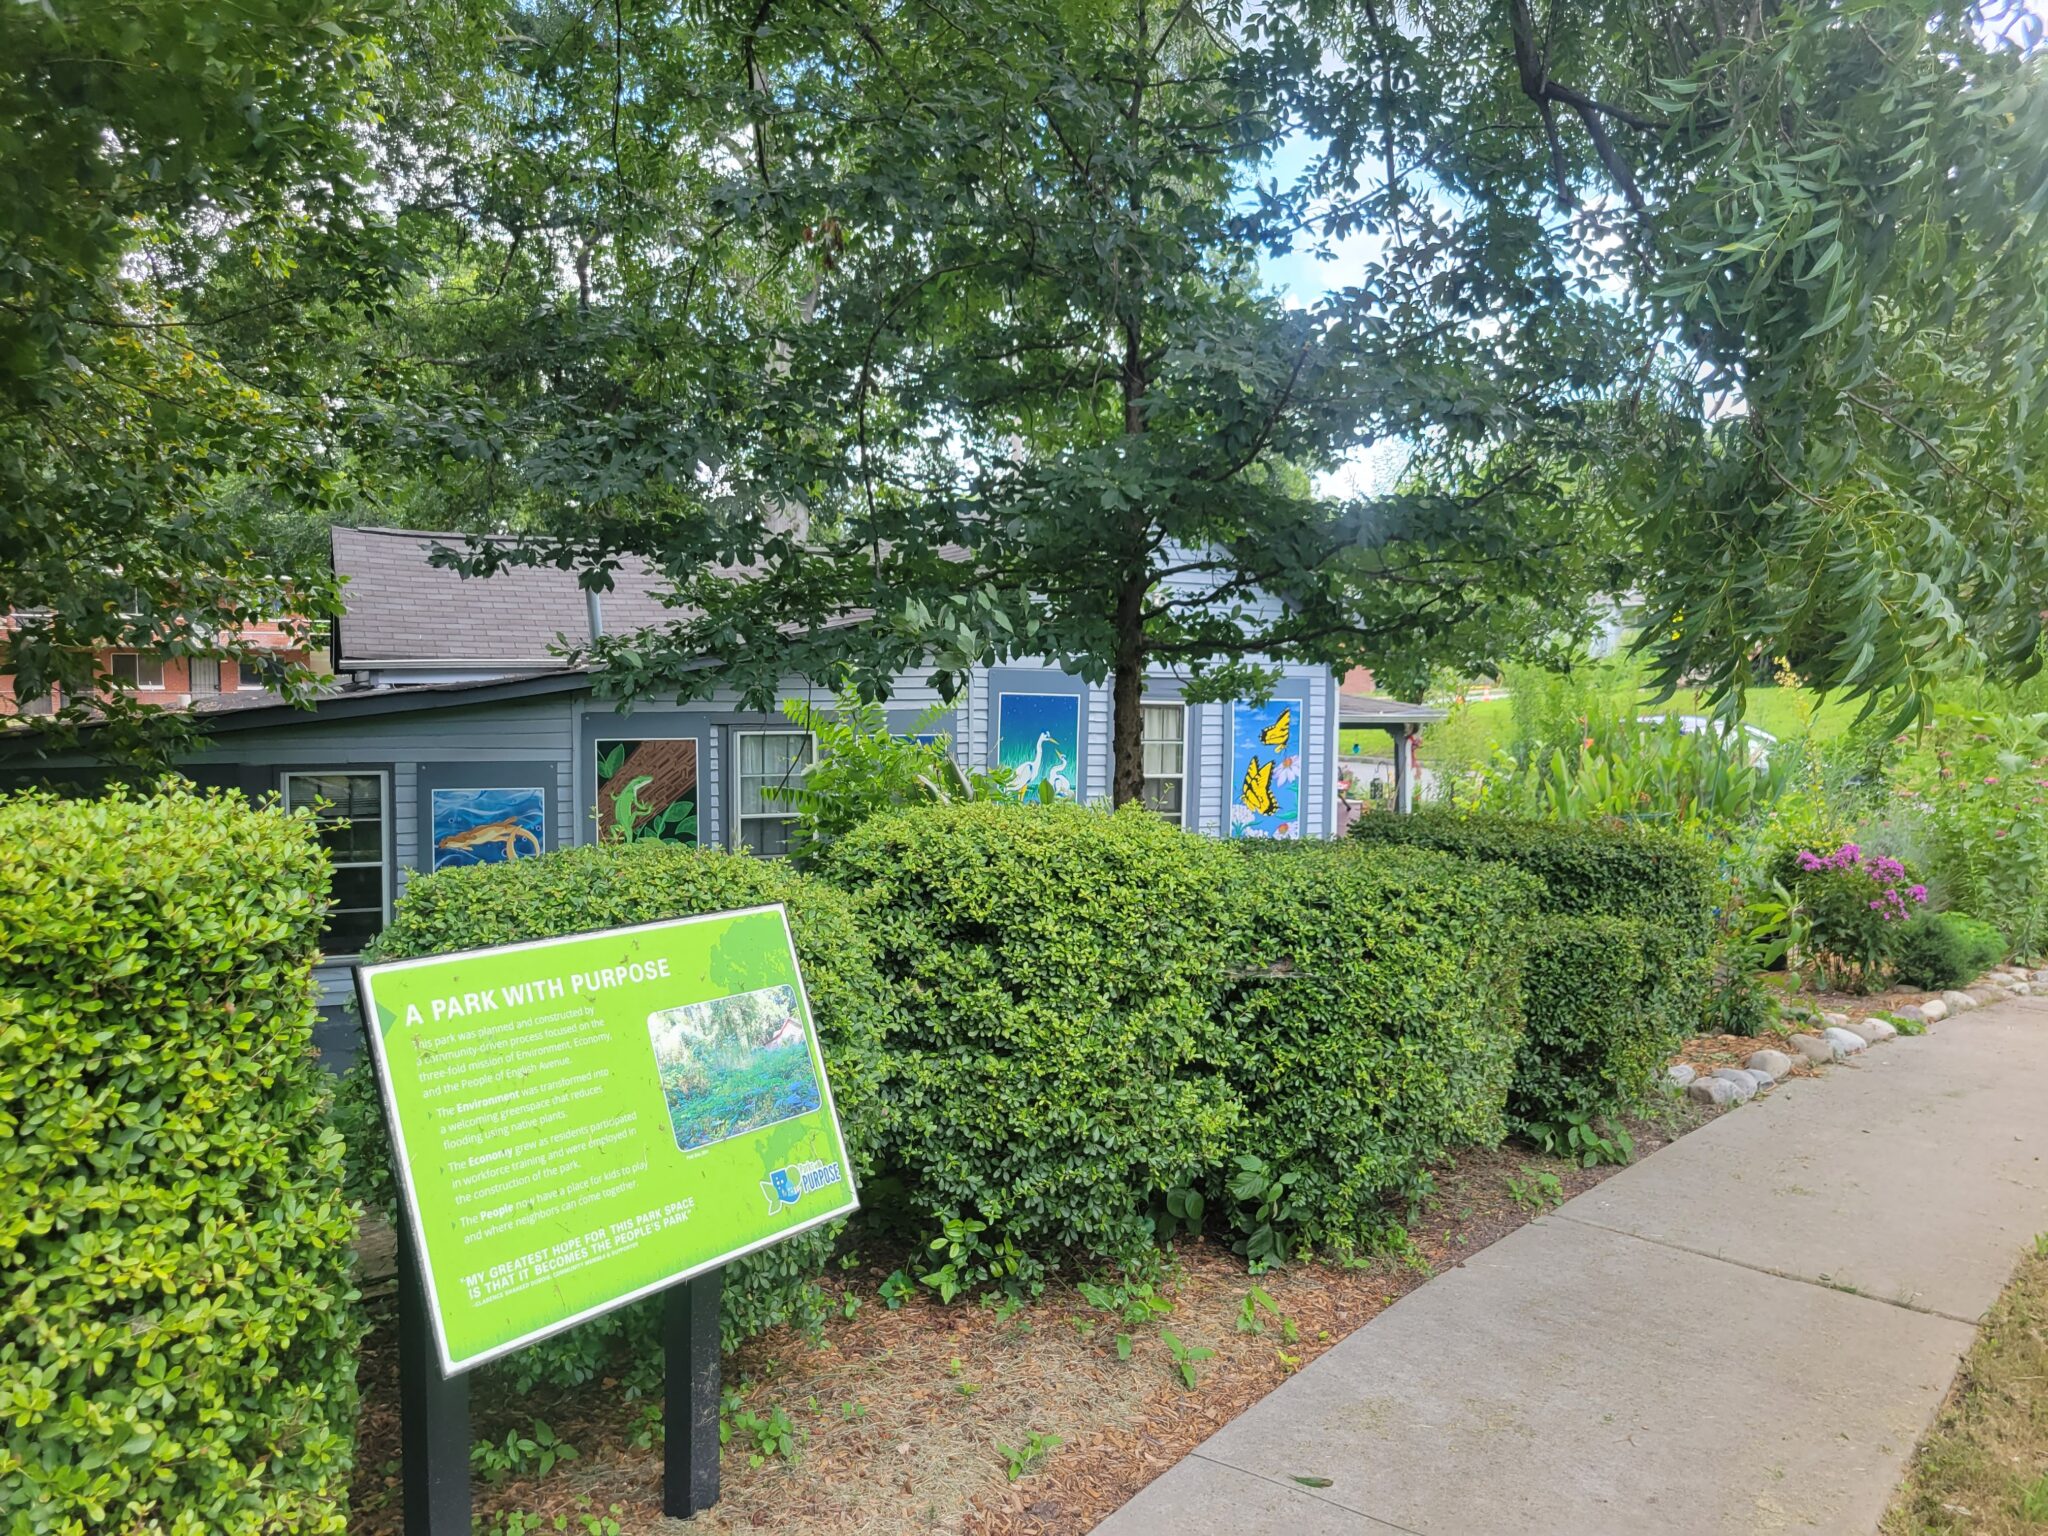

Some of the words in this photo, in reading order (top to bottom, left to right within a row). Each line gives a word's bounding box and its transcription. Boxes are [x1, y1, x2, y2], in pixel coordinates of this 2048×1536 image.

[405, 1003, 424, 1026] A
[431, 989, 499, 1021] PARK
[501, 977, 564, 1007] WITH
[570, 958, 671, 994] PURPOSE
[411, 1039, 433, 1050] This
[434, 1033, 455, 1048] park
[457, 1030, 476, 1041] was
[477, 1021, 515, 1039] planned
[516, 1018, 533, 1029] and
[534, 1007, 583, 1025] constructed
[583, 1006, 594, 1016] by
[423, 1039, 509, 1064] community-driven
[509, 1031, 544, 1048] process
[543, 1023, 577, 1037] focused
[578, 1022, 590, 1031] on
[590, 1019, 605, 1028] the
[418, 1063, 467, 1082] three-fold
[467, 1056, 504, 1071] mission
[504, 1051, 514, 1063] of
[515, 1040, 572, 1060] Environment,
[572, 1032, 612, 1047] Economy,
[422, 1085, 442, 1098] and
[443, 1082, 459, 1093] the
[460, 1074, 493, 1089] People
[494, 1070, 504, 1081] of
[505, 1063, 537, 1079] English
[538, 1056, 570, 1070] Avenue.
[436, 1107, 455, 1117] The
[456, 1090, 520, 1113] Environment
[520, 1086, 539, 1097] was
[539, 1072, 592, 1092] transformed
[593, 1068, 609, 1078] into
[440, 1125, 447, 1135] a
[447, 1112, 499, 1132] welcoming
[500, 1099, 550, 1121] greenspace
[551, 1093, 569, 1105] that
[570, 1086, 603, 1099] reduces
[443, 1133, 483, 1149] flooding
[484, 1125, 510, 1139] using
[511, 1118, 537, 1131] native
[538, 1110, 566, 1126] plants.
[447, 1160, 467, 1171] The
[467, 1147, 513, 1167] Economy
[514, 1141, 537, 1156] grew
[538, 1137, 549, 1147] as
[550, 1126, 589, 1142] residents
[589, 1111, 637, 1134] participated
[451, 1179, 462, 1189] in
[462, 1165, 510, 1185] workforce
[511, 1154, 547, 1170] training
[548, 1147, 564, 1160] and
[565, 1142, 586, 1155] were
[587, 1129, 628, 1149] employed
[627, 1127, 636, 1135] in
[455, 1193, 471, 1205] the
[473, 1175, 531, 1199] construction
[531, 1169, 541, 1181] of
[542, 1167, 558, 1177] the
[559, 1159, 580, 1175] park.
[802, 1163, 840, 1191] PURPOSE
[459, 1215, 478, 1227] The
[479, 1203, 513, 1221] People
[515, 1197, 535, 1209] now
[535, 1190, 558, 1202] have
[559, 1187, 565, 1196] a
[566, 1179, 589, 1195] place
[589, 1175, 601, 1185] for
[603, 1169, 621, 1181] kids
[621, 1166, 631, 1176] to
[631, 1161, 648, 1173] play
[464, 1228, 483, 1244] and
[483, 1221, 513, 1237] where
[515, 1206, 560, 1226] neighbors
[561, 1200, 577, 1211] can
[578, 1192, 601, 1205] come
[601, 1180, 636, 1198] together.
[489, 1248, 548, 1279] GREATEST
[551, 1237, 581, 1256] HOPE
[584, 1228, 606, 1244] FOR
[609, 1218, 634, 1234] THIS
[635, 1208, 662, 1225] PARK
[664, 1197, 694, 1216] SPACE
[468, 1286, 481, 1299] IS
[484, 1272, 514, 1293] THAT
[518, 1267, 529, 1281] IT
[534, 1247, 588, 1275] BECOMES
[590, 1238, 612, 1253] THE
